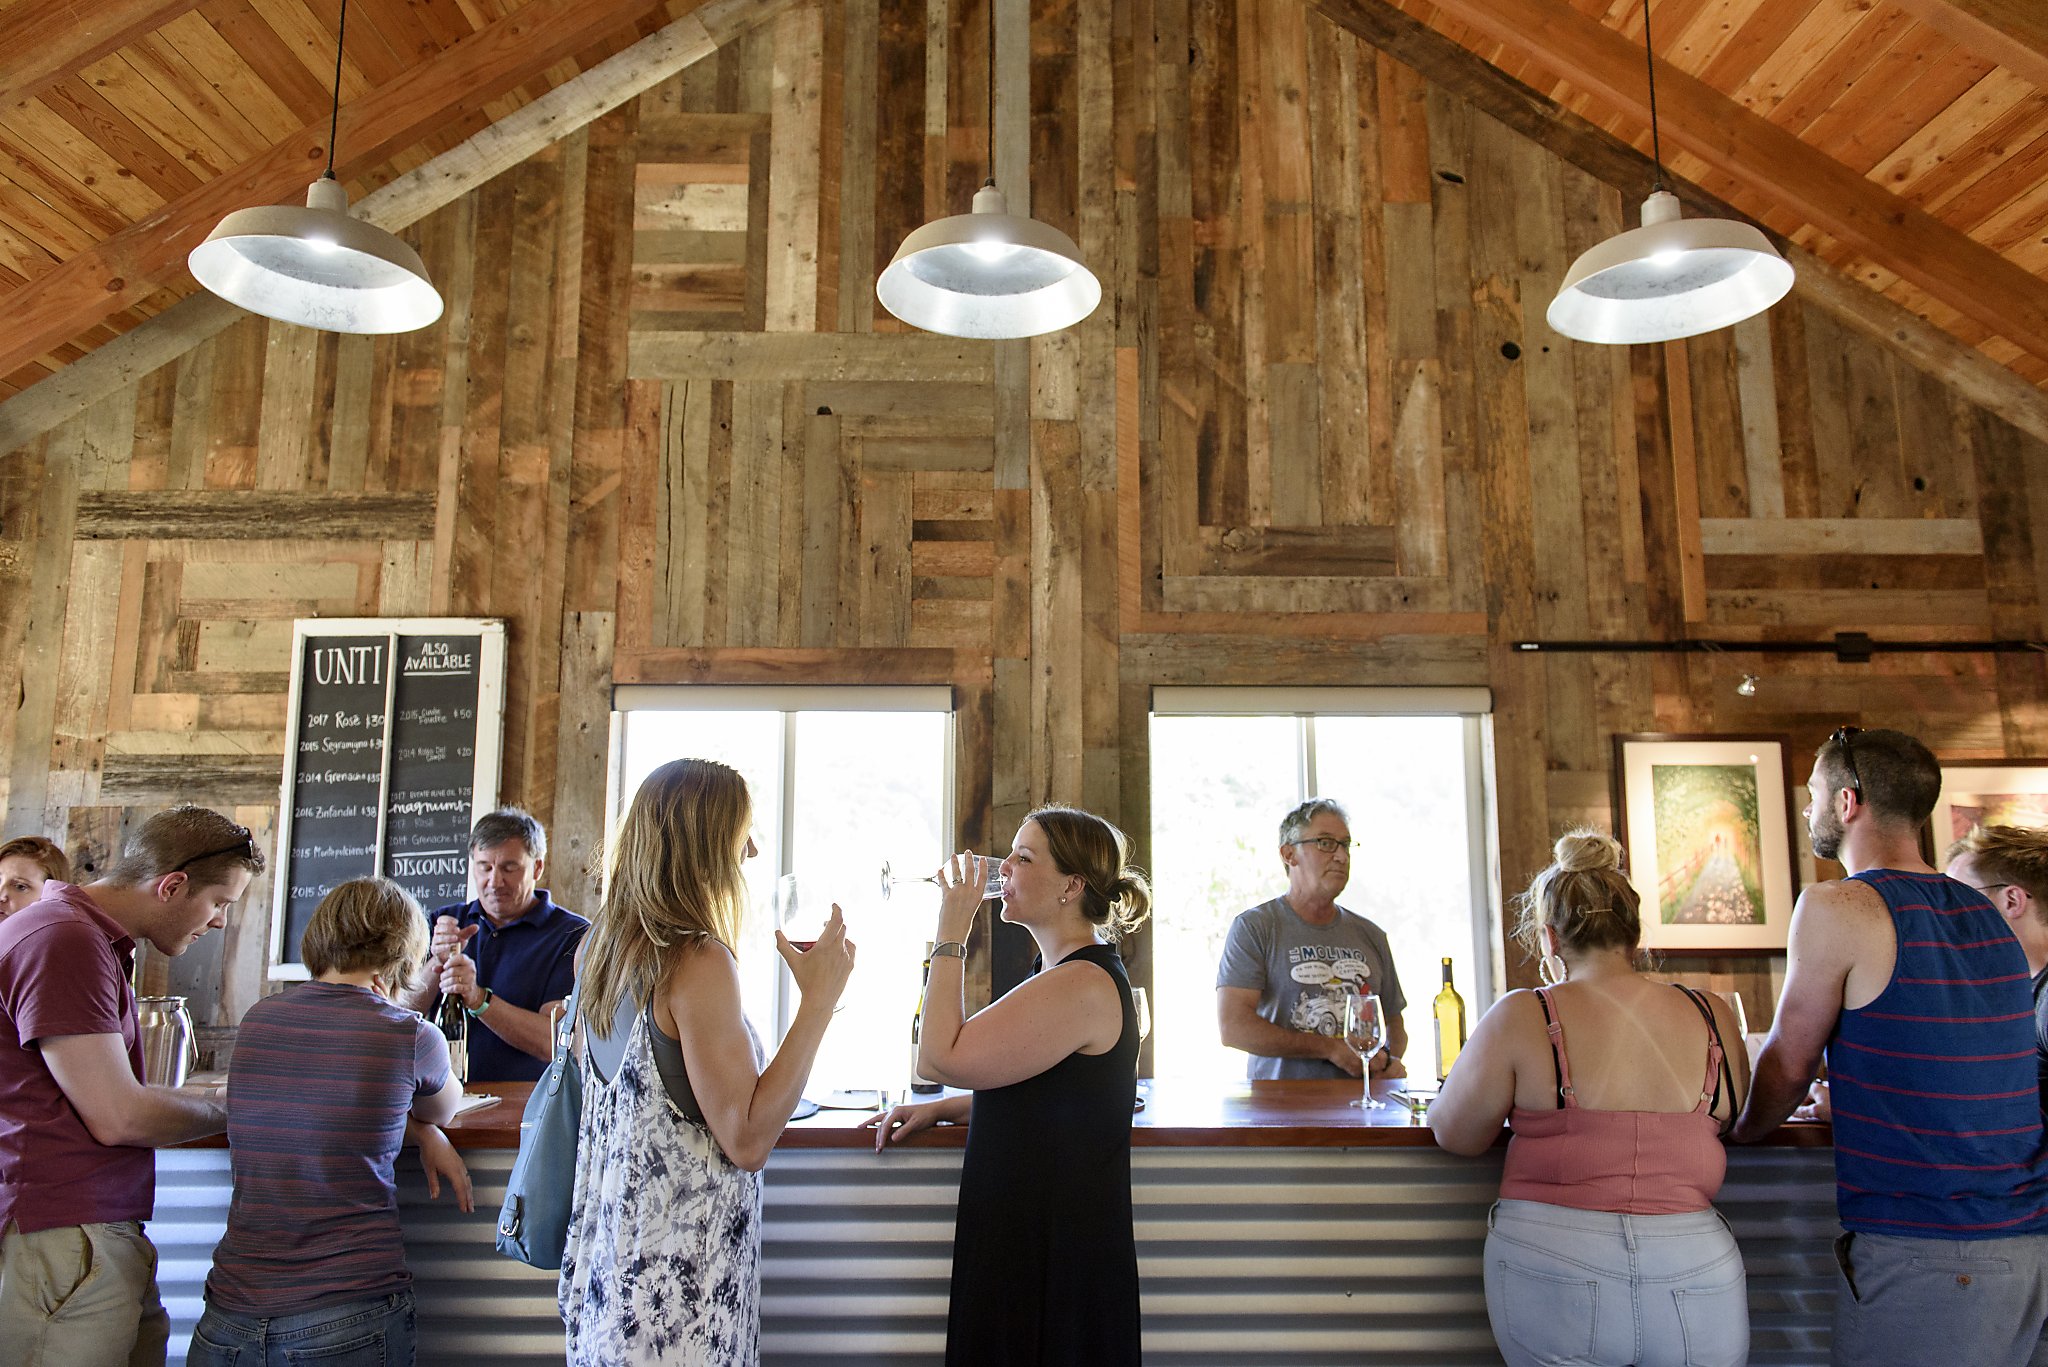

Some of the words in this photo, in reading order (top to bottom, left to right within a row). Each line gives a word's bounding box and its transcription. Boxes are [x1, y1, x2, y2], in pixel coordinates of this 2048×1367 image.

[421, 642, 449, 656] ALSO
[313, 645, 382, 685] UNTI
[404, 654, 471, 671] AVAILABLE
[308, 713, 329, 728] 2017
[300, 741, 319, 752] 2015
[297, 772, 321, 784] 2014
[316, 804, 356, 818] Zinfandel
[388, 800, 471, 816] magnums
[411, 833, 449, 846] Grenache
[393, 857, 467, 877] DISCOUNTS
[291, 886, 315, 899] 2015
[1301, 945, 1367, 963] MOLINO
